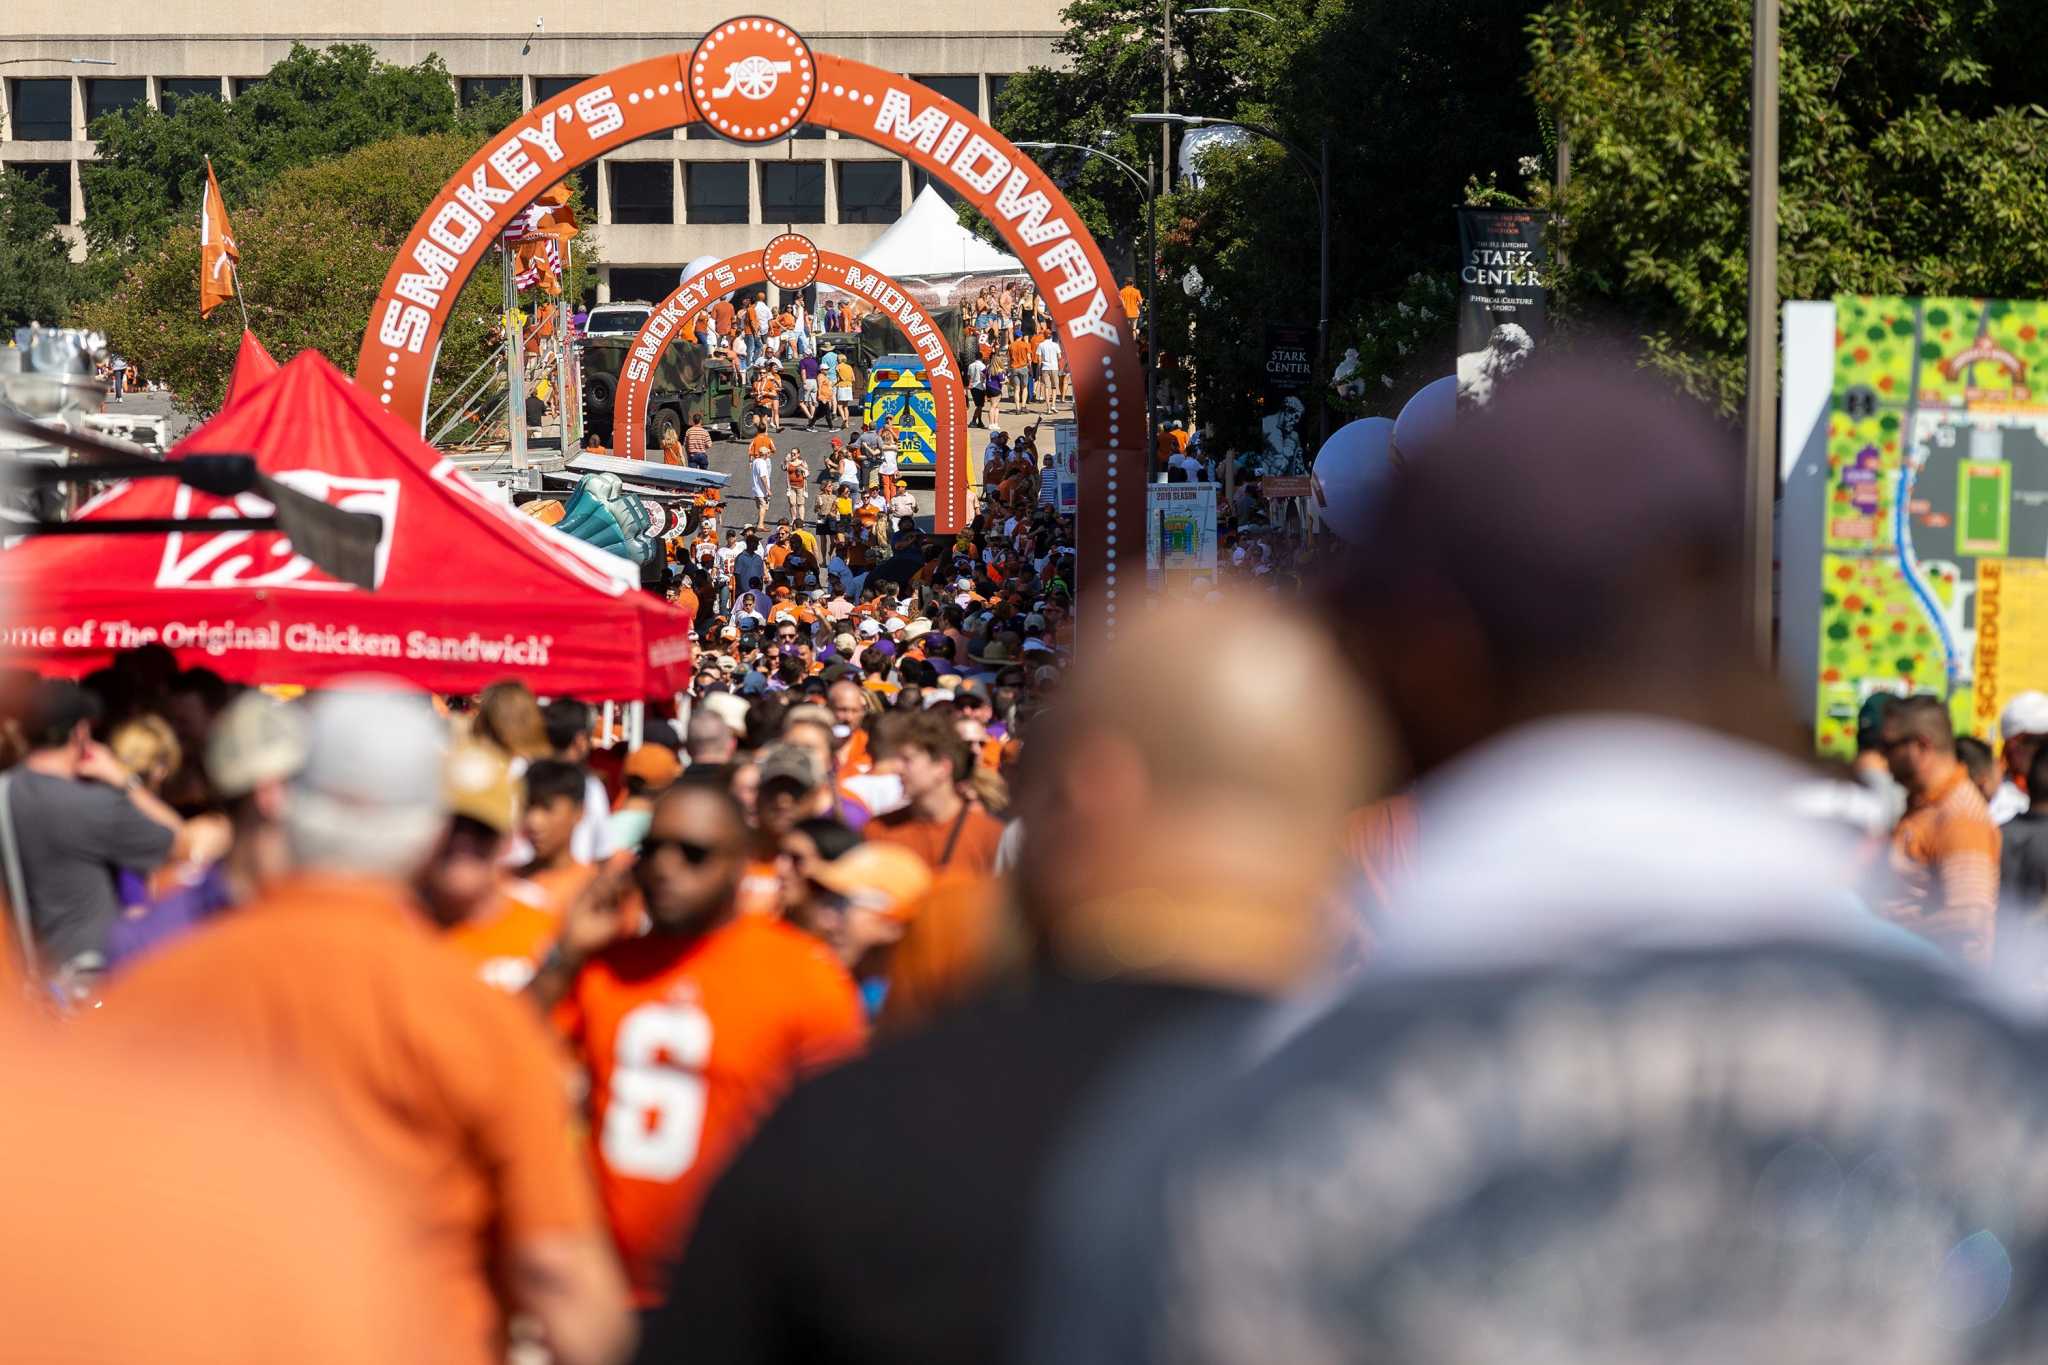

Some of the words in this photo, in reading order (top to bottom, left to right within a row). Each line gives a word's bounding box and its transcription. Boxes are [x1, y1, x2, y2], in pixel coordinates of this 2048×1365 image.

[379, 85, 624, 354] SMOKEY'S
[873, 88, 1120, 347] MIDWAY
[1471, 249, 1534, 266] STARK
[626, 264, 733, 382] SMOKEY'S
[844, 266, 955, 381] MIDWAY
[1266, 360, 1311, 374] CENTER
[1271, 350, 1308, 362] STARK
[62, 619, 97, 648] of
[100, 620, 158, 648] The
[162, 620, 280, 656] Original
[284, 623, 401, 658] Chicken
[1976, 564, 2001, 718] SCHEDULE
